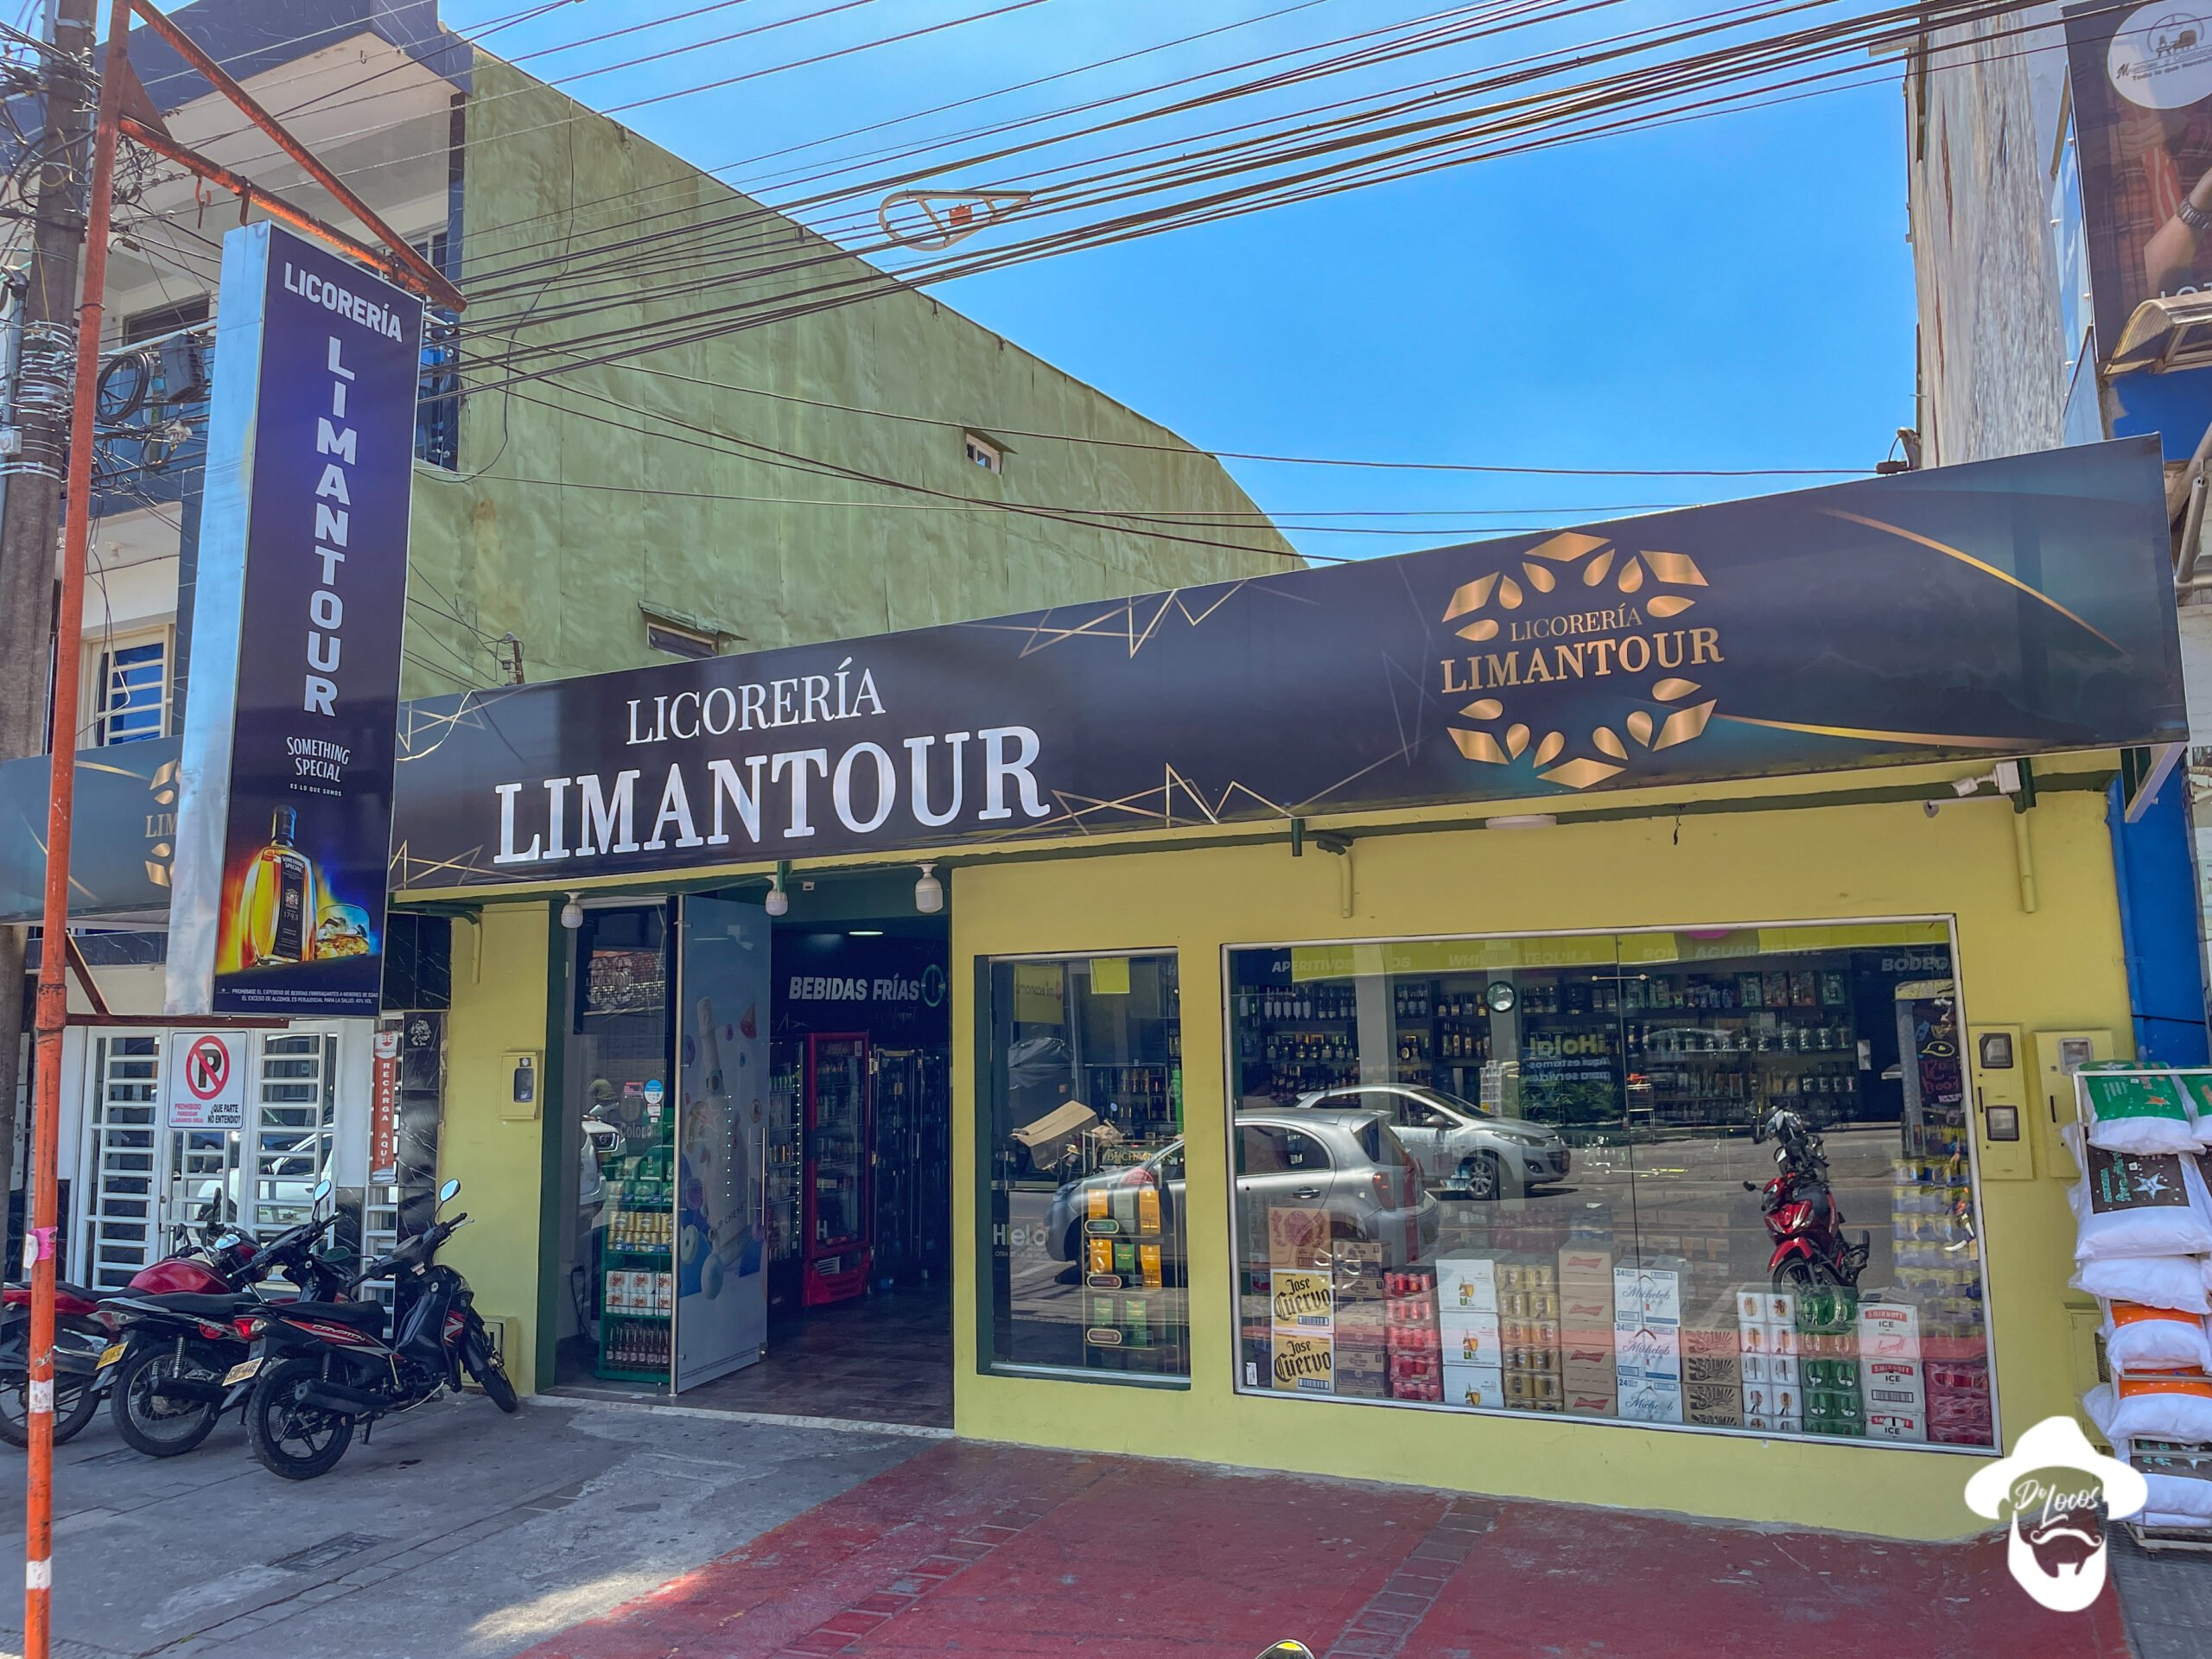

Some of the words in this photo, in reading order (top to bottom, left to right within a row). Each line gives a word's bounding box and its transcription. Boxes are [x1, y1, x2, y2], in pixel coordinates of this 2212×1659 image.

[284, 262, 403, 343] LICORERÍA
[303, 336, 358, 717] LIMANTOUR
[1510, 603, 1643, 642] LICORERÍA
[1440, 626, 1726, 694] LIMANTOUR
[626, 657, 887, 746] LICORERÍA
[286, 736, 351, 766] SOMETHING
[295, 757, 341, 783] SPECIAL
[493, 725, 1051, 864] LIMANTOUR
[1881, 956, 1949, 972] BODEG
[789, 976, 868, 1001] BEBIDAS
[873, 973, 919, 1001] FRÍAS
[380, 1062, 391, 1122] RECARGA
[207, 1115, 214, 1123] NO
[211, 1103, 223, 1115] ¿QUE
[224, 1103, 238, 1113] PARTE
[380, 1132, 389, 1165] AQUI
[1274, 1287, 1331, 1321] Cuervo
[1274, 1351, 1332, 1382] Cuervo
[1874, 1364, 1910, 1374] SMIRNOFF
[1625, 1396, 1673, 1410] Micheb
[1885, 1427, 1901, 1435] ICE
